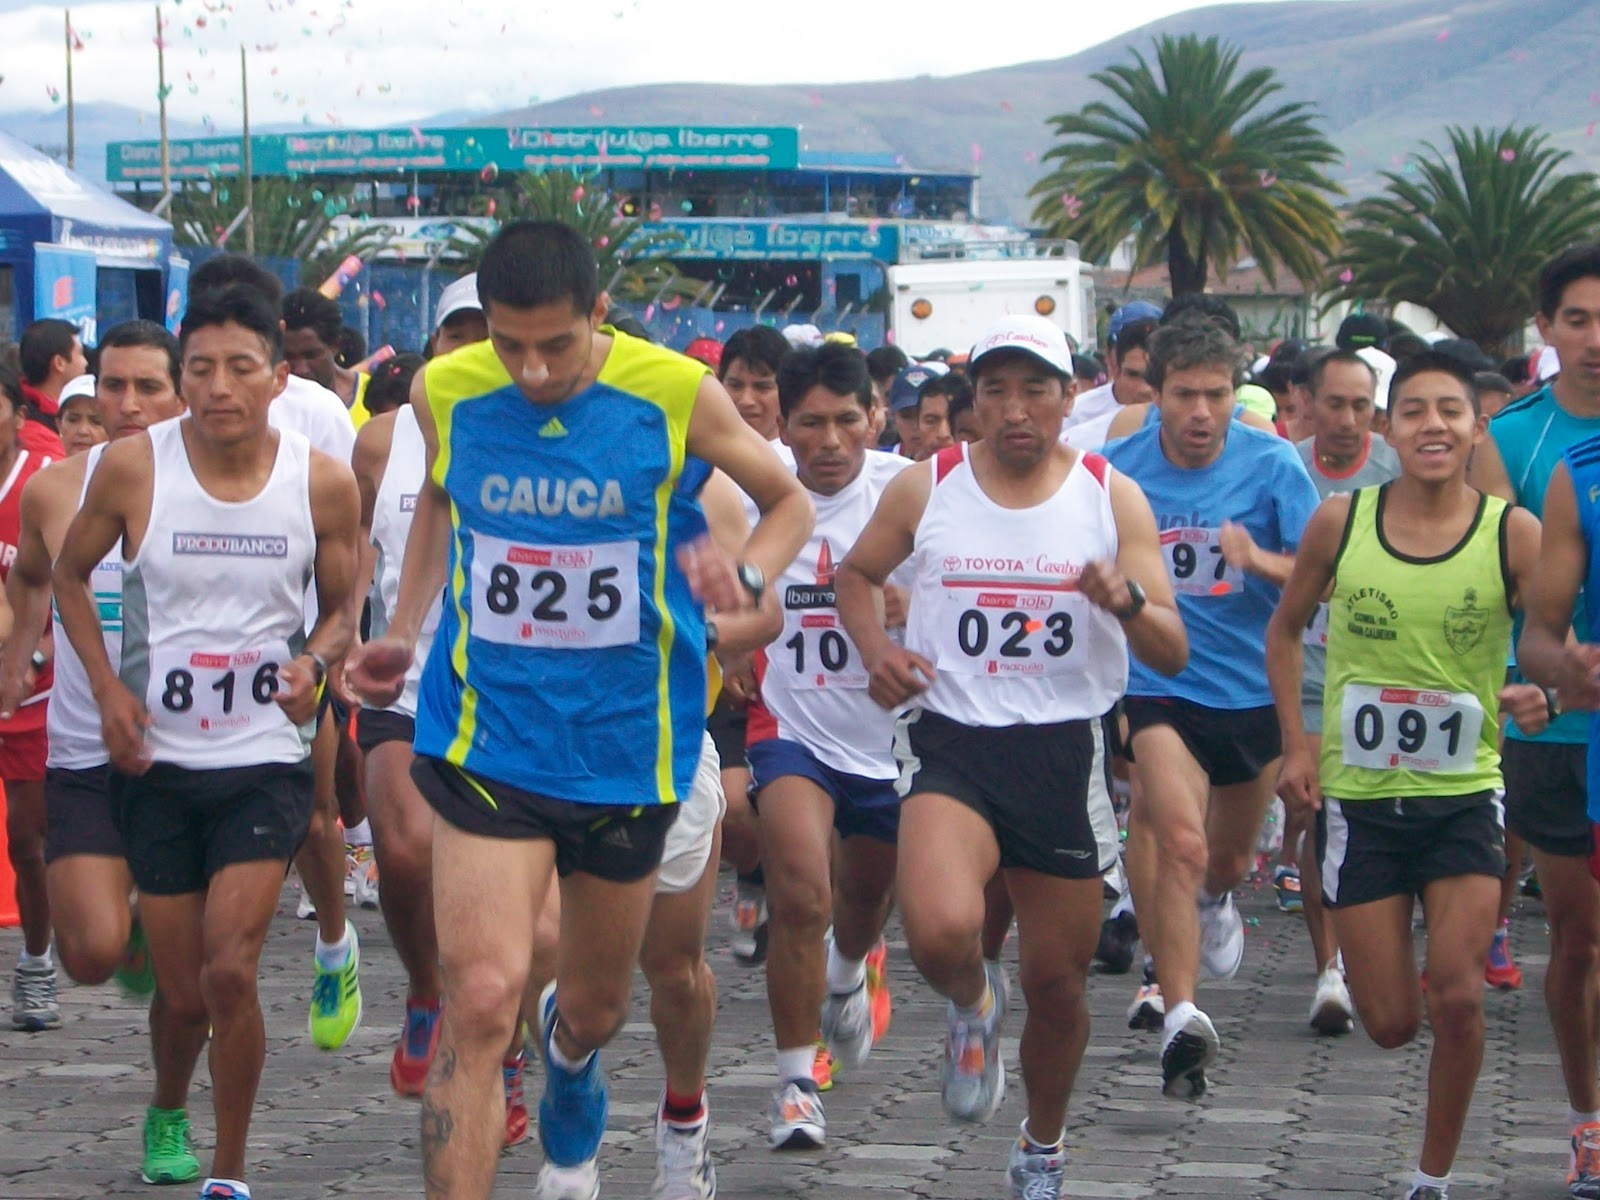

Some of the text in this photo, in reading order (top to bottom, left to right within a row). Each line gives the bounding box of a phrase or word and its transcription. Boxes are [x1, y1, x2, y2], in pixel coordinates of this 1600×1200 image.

[678, 129, 772, 148] Ibarra
[766, 225, 882, 248] Ibarra
[480, 473, 626, 518] CAUCA
[175, 533, 287, 556] PRODUBANCO
[964, 557, 1024, 572] TOYOTA
[486, 563, 622, 622] 825
[787, 589, 837, 604] Ibarra
[1346, 587, 1399, 620] ATLETISMO
[786, 630, 849, 674] 10
[958, 609, 1074, 657] 023
[161, 662, 280, 714] 816
[1354, 704, 1463, 757] 091
